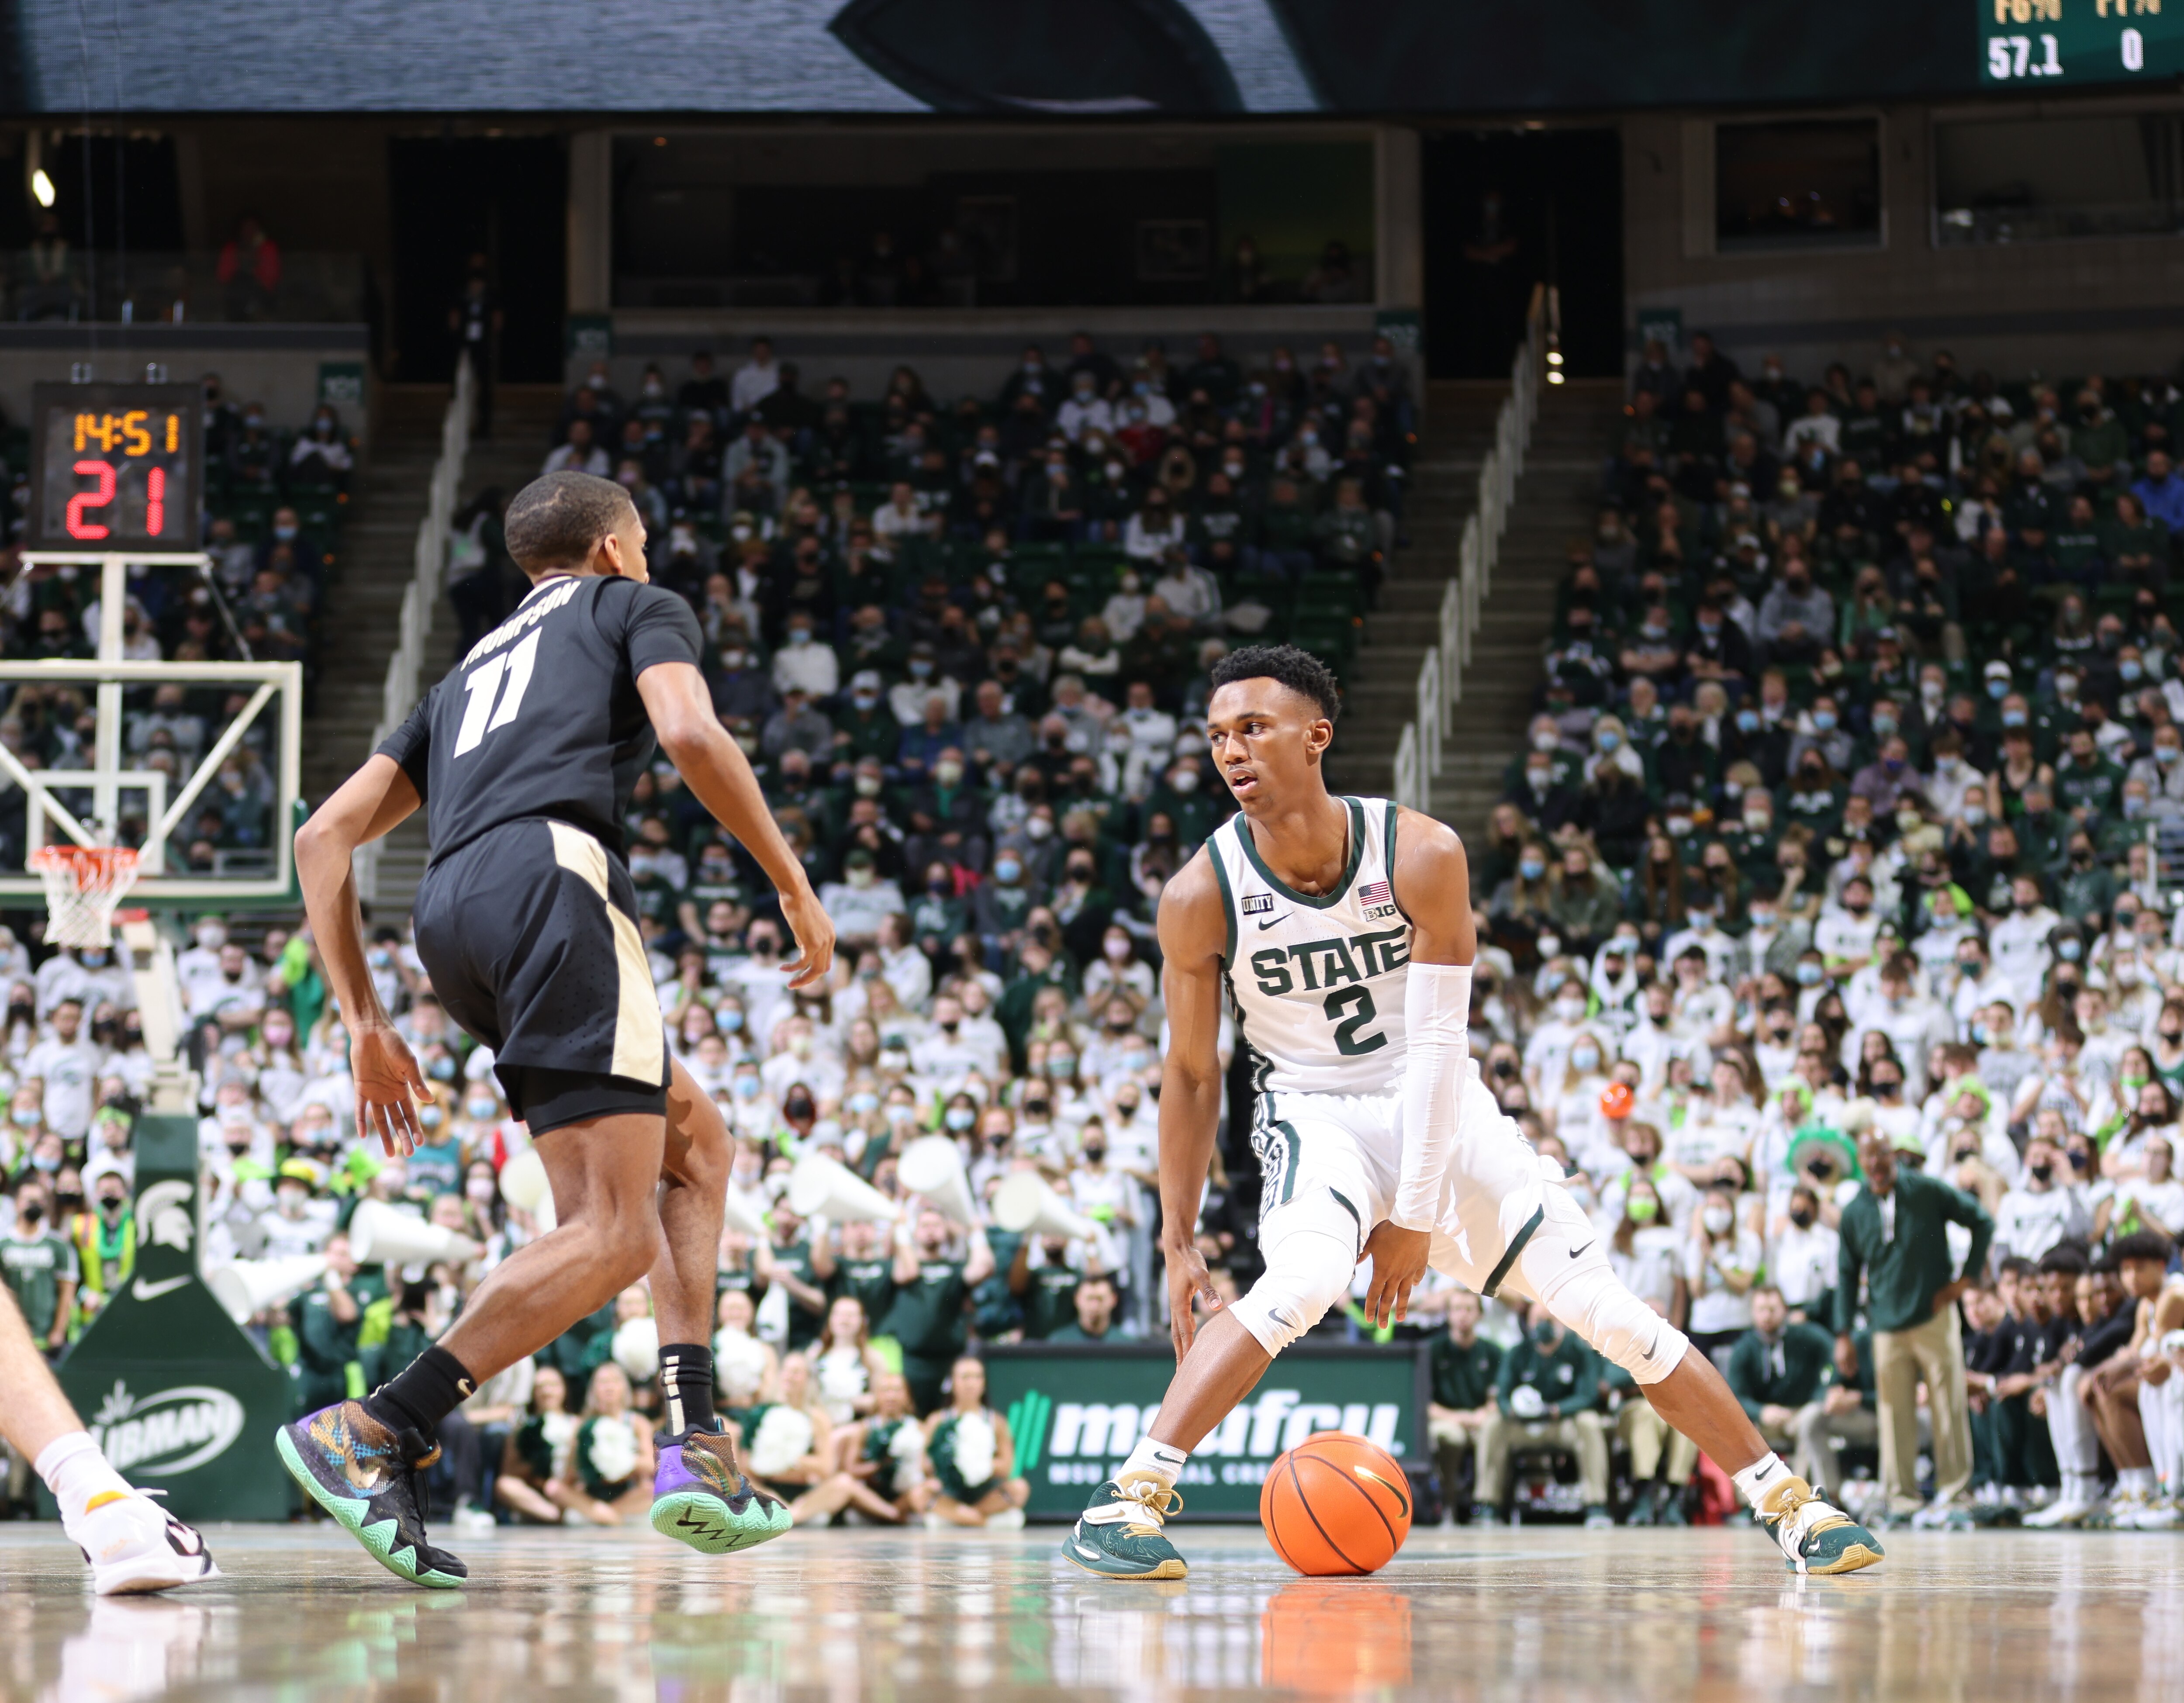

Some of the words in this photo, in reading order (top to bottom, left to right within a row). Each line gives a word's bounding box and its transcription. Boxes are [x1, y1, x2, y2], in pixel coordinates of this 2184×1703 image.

[1988, 33, 2064, 80] 57.1
[2121, 27, 2144, 72] 0
[73, 410, 180, 457] 14:51
[66, 460, 165, 540] 21
[454, 626, 543, 759] 11
[1241, 895, 1272, 912] UNITY
[1251, 924, 1410, 997] STATE
[1323, 984, 1389, 1056] 2
